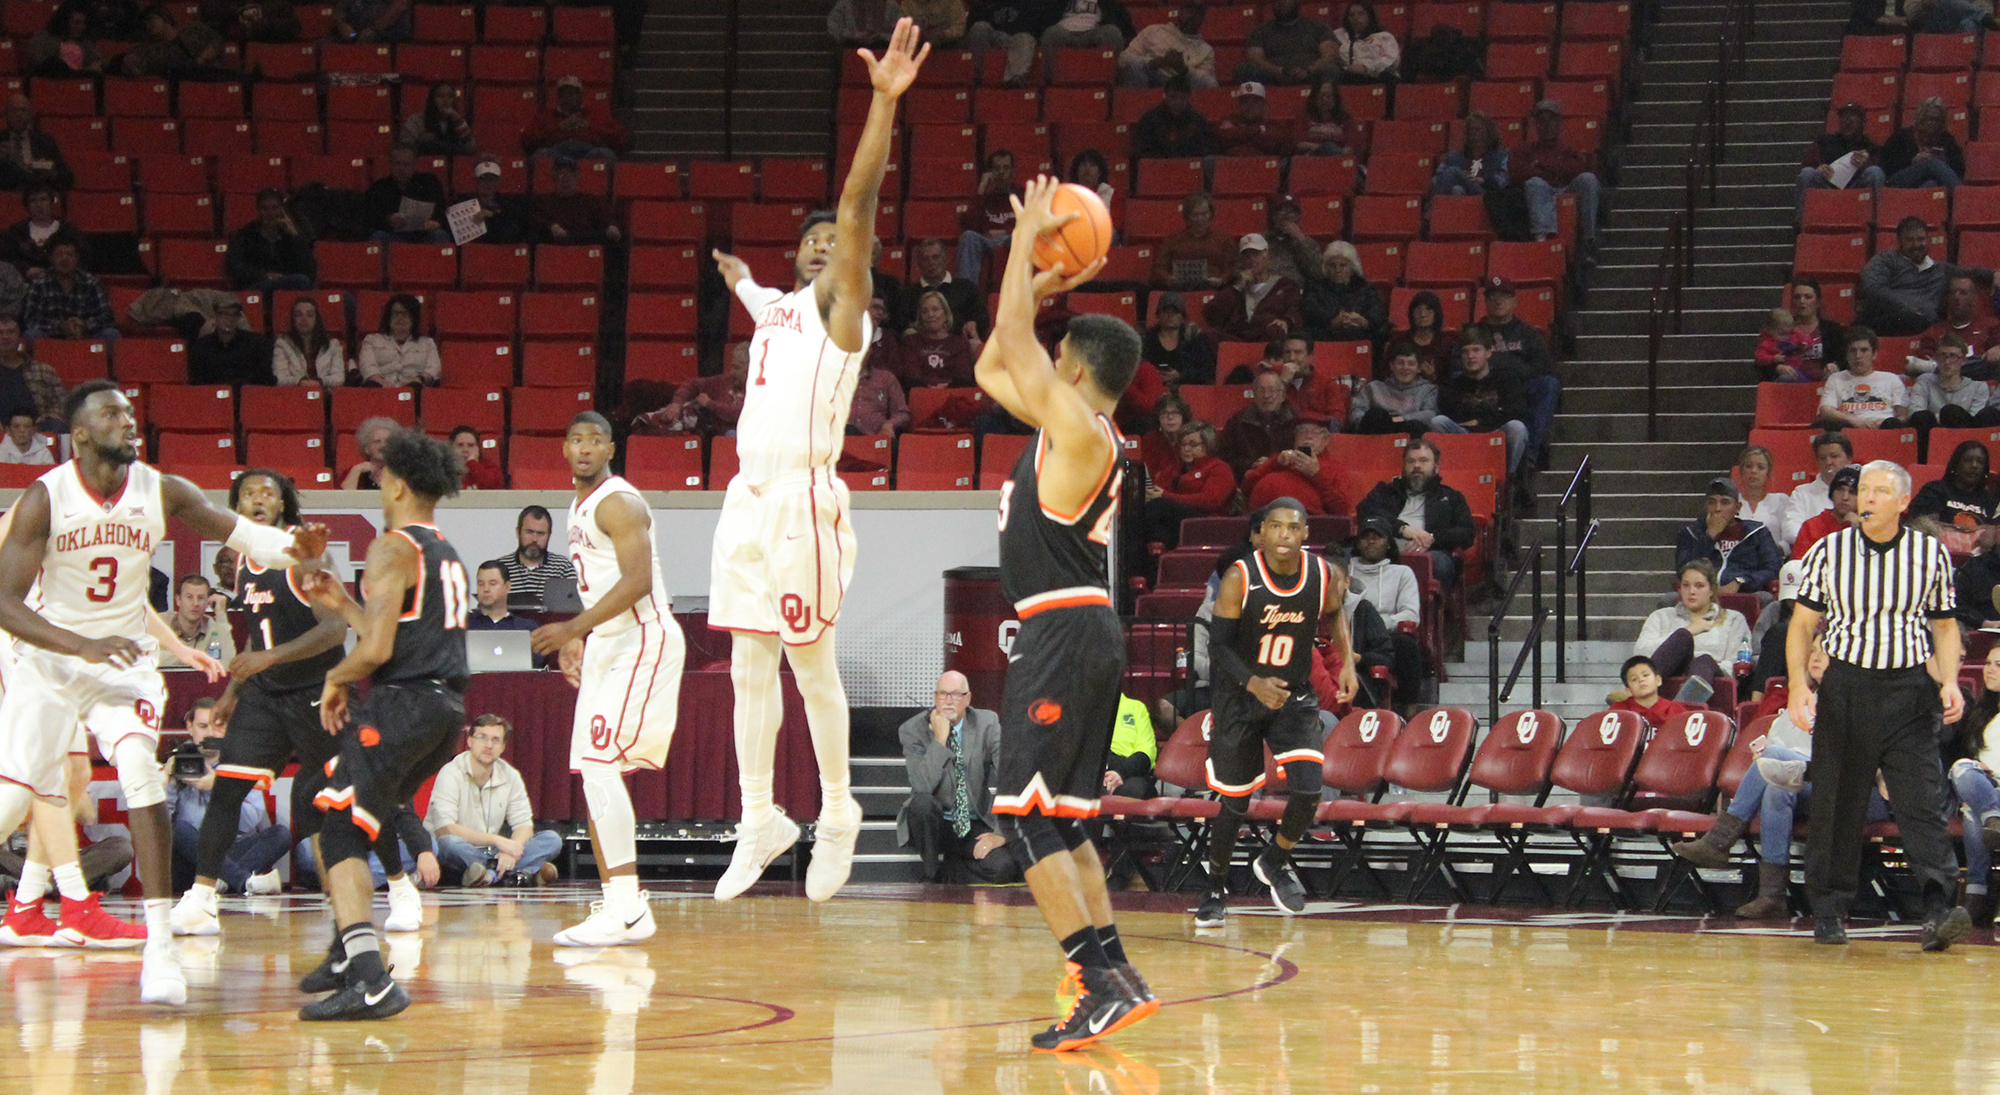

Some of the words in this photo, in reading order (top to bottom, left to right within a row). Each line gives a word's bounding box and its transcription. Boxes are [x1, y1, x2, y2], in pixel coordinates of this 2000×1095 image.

[755, 338, 771, 386] 1
[56, 523, 151, 552] OKLAHOMA
[86, 556, 118, 602] 3
[440, 560, 469, 629] 11
[243, 582, 275, 613] Tigers
[780, 593, 811, 633] OU
[1259, 604, 1306, 630] Tigers
[259, 618, 274, 650] 1
[1257, 633, 1294, 667] 10
[590, 714, 612, 751] OU
[1358, 711, 1380, 743] OU
[1429, 710, 1451, 743] OU
[1516, 711, 1539, 744] OU
[1599, 712, 1622, 745] OU
[1685, 713, 1707, 747] OU
